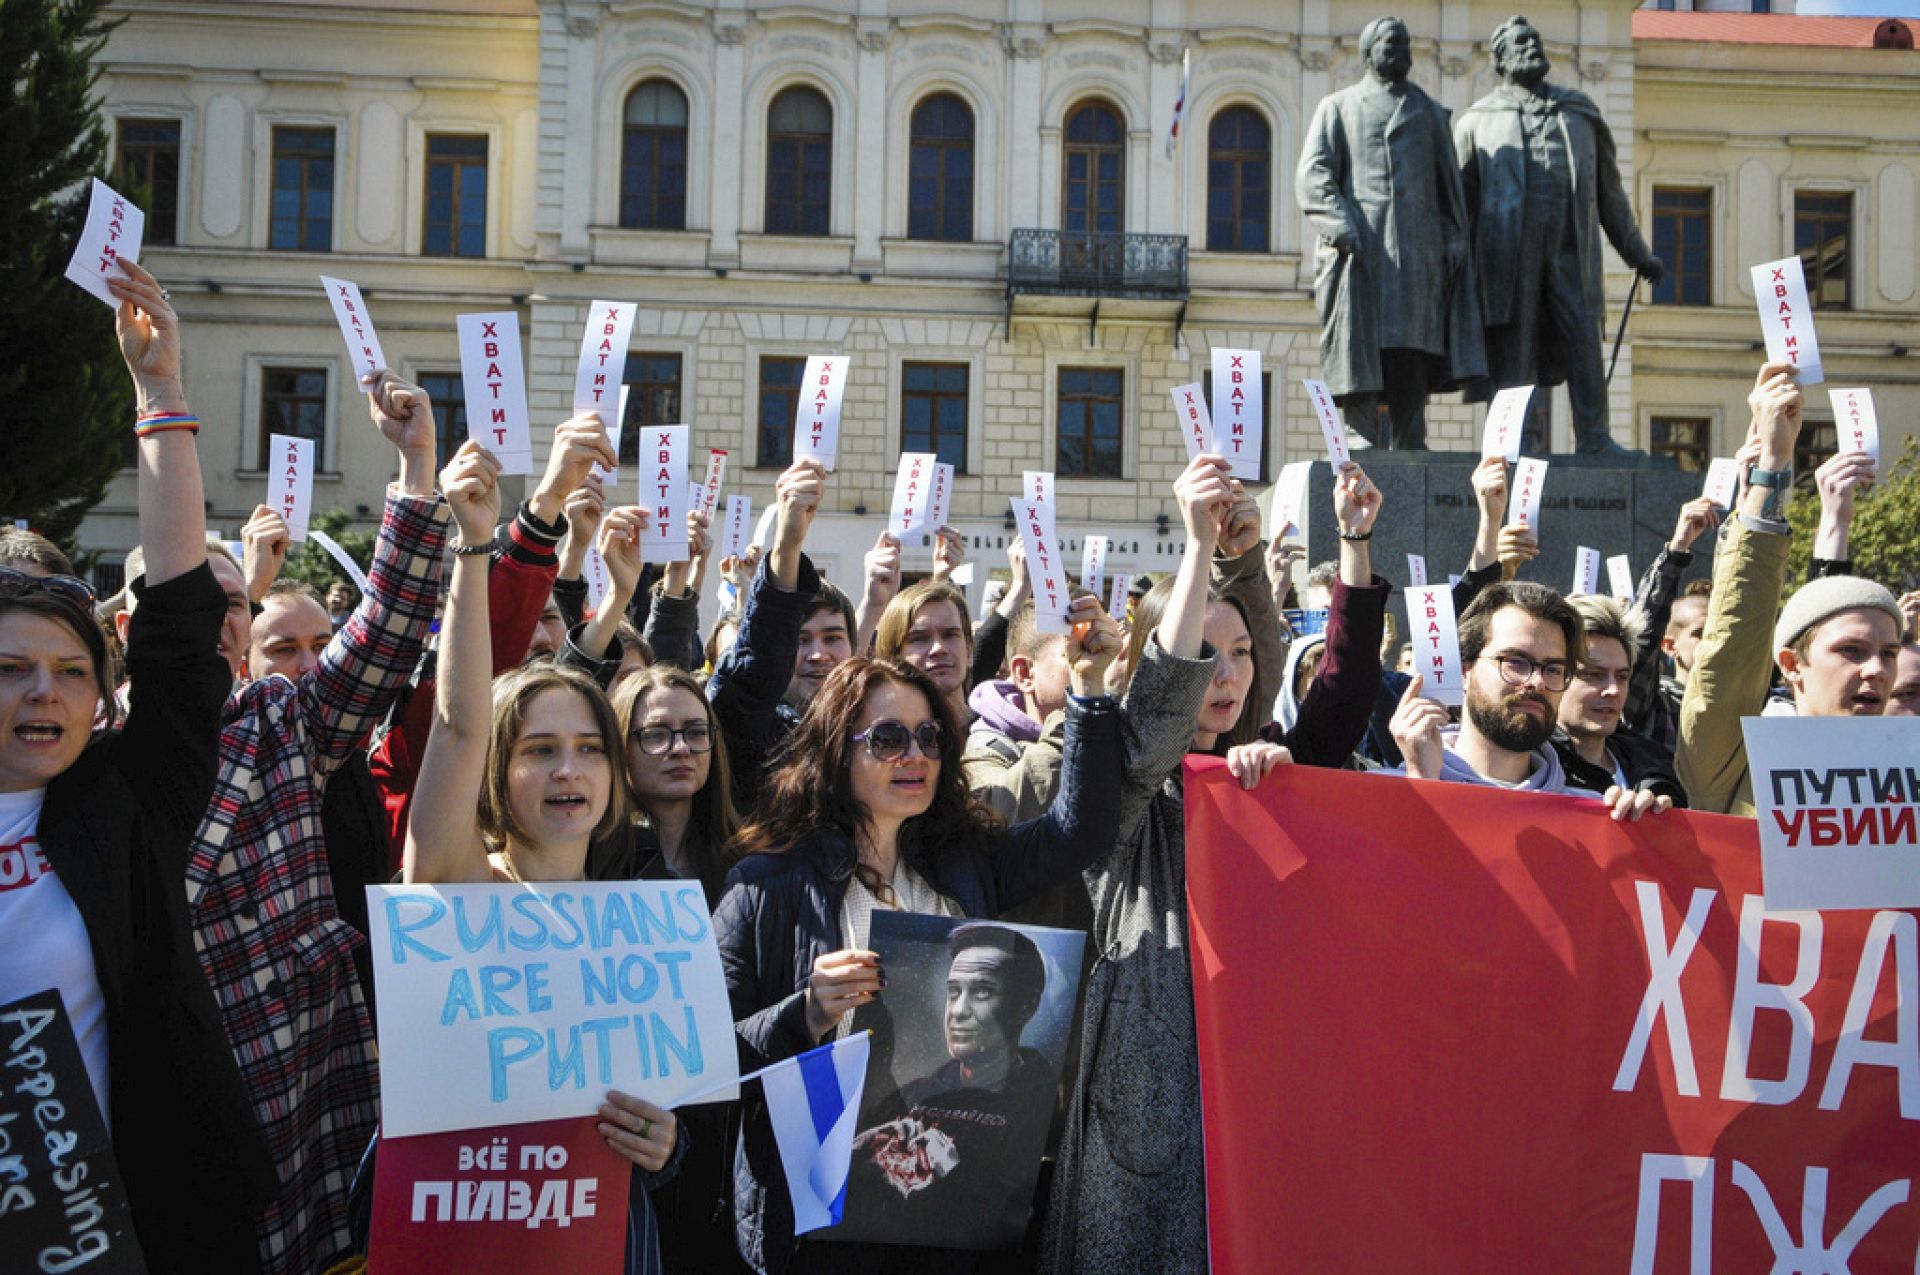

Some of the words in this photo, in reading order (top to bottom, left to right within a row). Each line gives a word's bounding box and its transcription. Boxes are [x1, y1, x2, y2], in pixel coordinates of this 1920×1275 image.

[98, 197, 126, 273] ХВАТИТ
[338, 284, 376, 369] ХВАТИТ
[593, 308, 618, 402] ХВАТИТ
[1772, 268, 1799, 364] ХВАТИТ
[482, 322, 507, 445] ХВАТИТ
[811, 362, 832, 448] ХВАТИТ
[1185, 392, 1204, 450] ХВАТ
[1231, 356, 1244, 452] ХВАТИТ
[284, 442, 298, 519] ХВАТИТ
[658, 433, 671, 537] ХВАТИТ
[904, 458, 921, 528] ХВАТИТ
[1035, 476, 1043, 501] ХВА
[1519, 465, 1535, 524] ХВАТИ
[1027, 507, 1056, 608] ХВАТИТ
[1424, 593, 1445, 684] ХВАТИТ
[384, 888, 708, 964] RUSSIANS
[440, 962, 552, 1025] ARE
[580, 951, 692, 1006] NOT
[488, 1005, 704, 1103] PUTIN
[0, 1009, 110, 1275] Appeasing
[459, 1138, 508, 1171] ВСЁ
[520, 1145, 568, 1171] ПО
